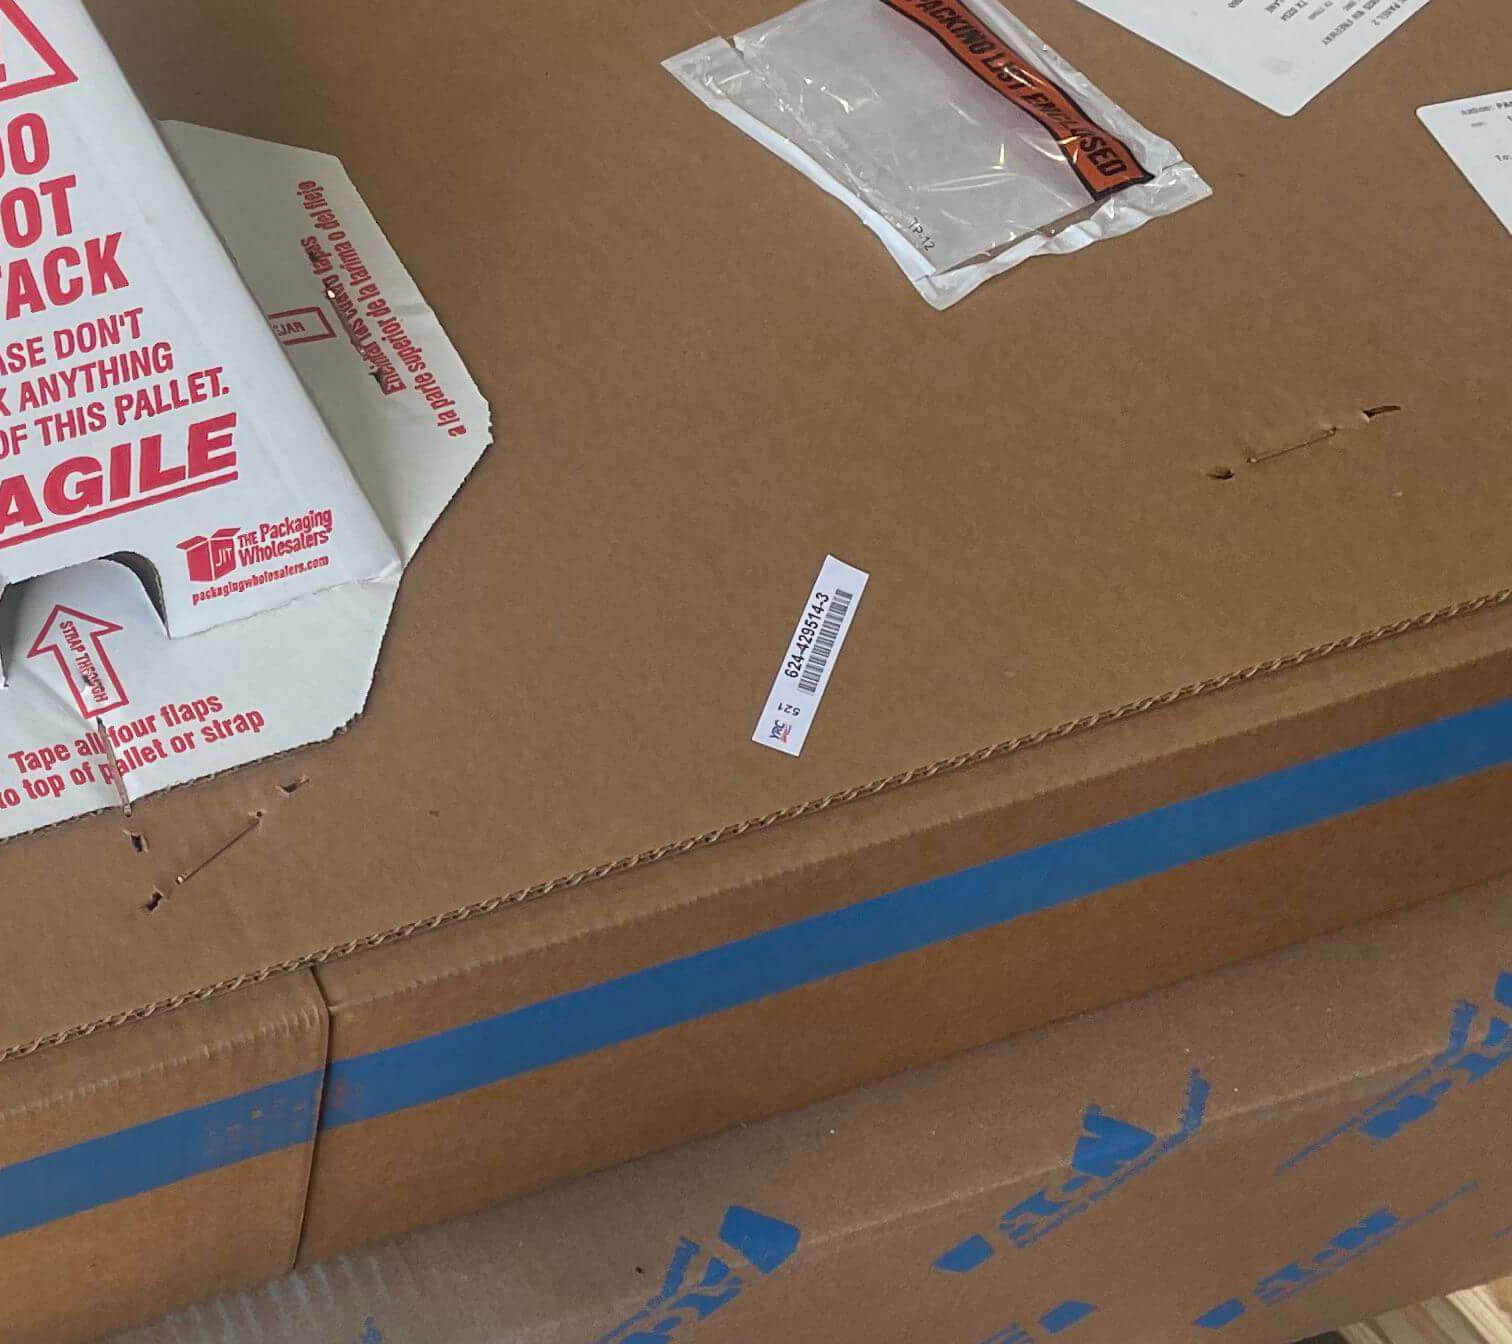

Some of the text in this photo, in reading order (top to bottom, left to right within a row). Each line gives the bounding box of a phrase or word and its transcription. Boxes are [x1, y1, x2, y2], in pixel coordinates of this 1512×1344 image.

[310, 210, 340, 229] del
[359, 283, 380, 302] la
[368, 299, 392, 319] de
[54, 308, 142, 359] DON'T
[378, 318, 427, 372] superior
[21, 342, 172, 410] ANYTHING
[414, 372, 457, 409] parte
[34, 401, 106, 444] THIS
[116, 367, 229, 424] PALLET.
[438, 409, 460, 427] la
[238, 510, 332, 548] THE Packaging
[60, 622, 85, 652] STRAP
[783, 590, 830, 679] 624-429514-3
[8, 745, 70, 773] Tape
[109, 716, 155, 747] four
[161, 696, 222, 726] flaps
[768, 718, 786, 741] YRC
[23, 774, 64, 800] top
[70, 761, 95, 784] of
[170, 732, 194, 752] or
[201, 712, 263, 742] strap
